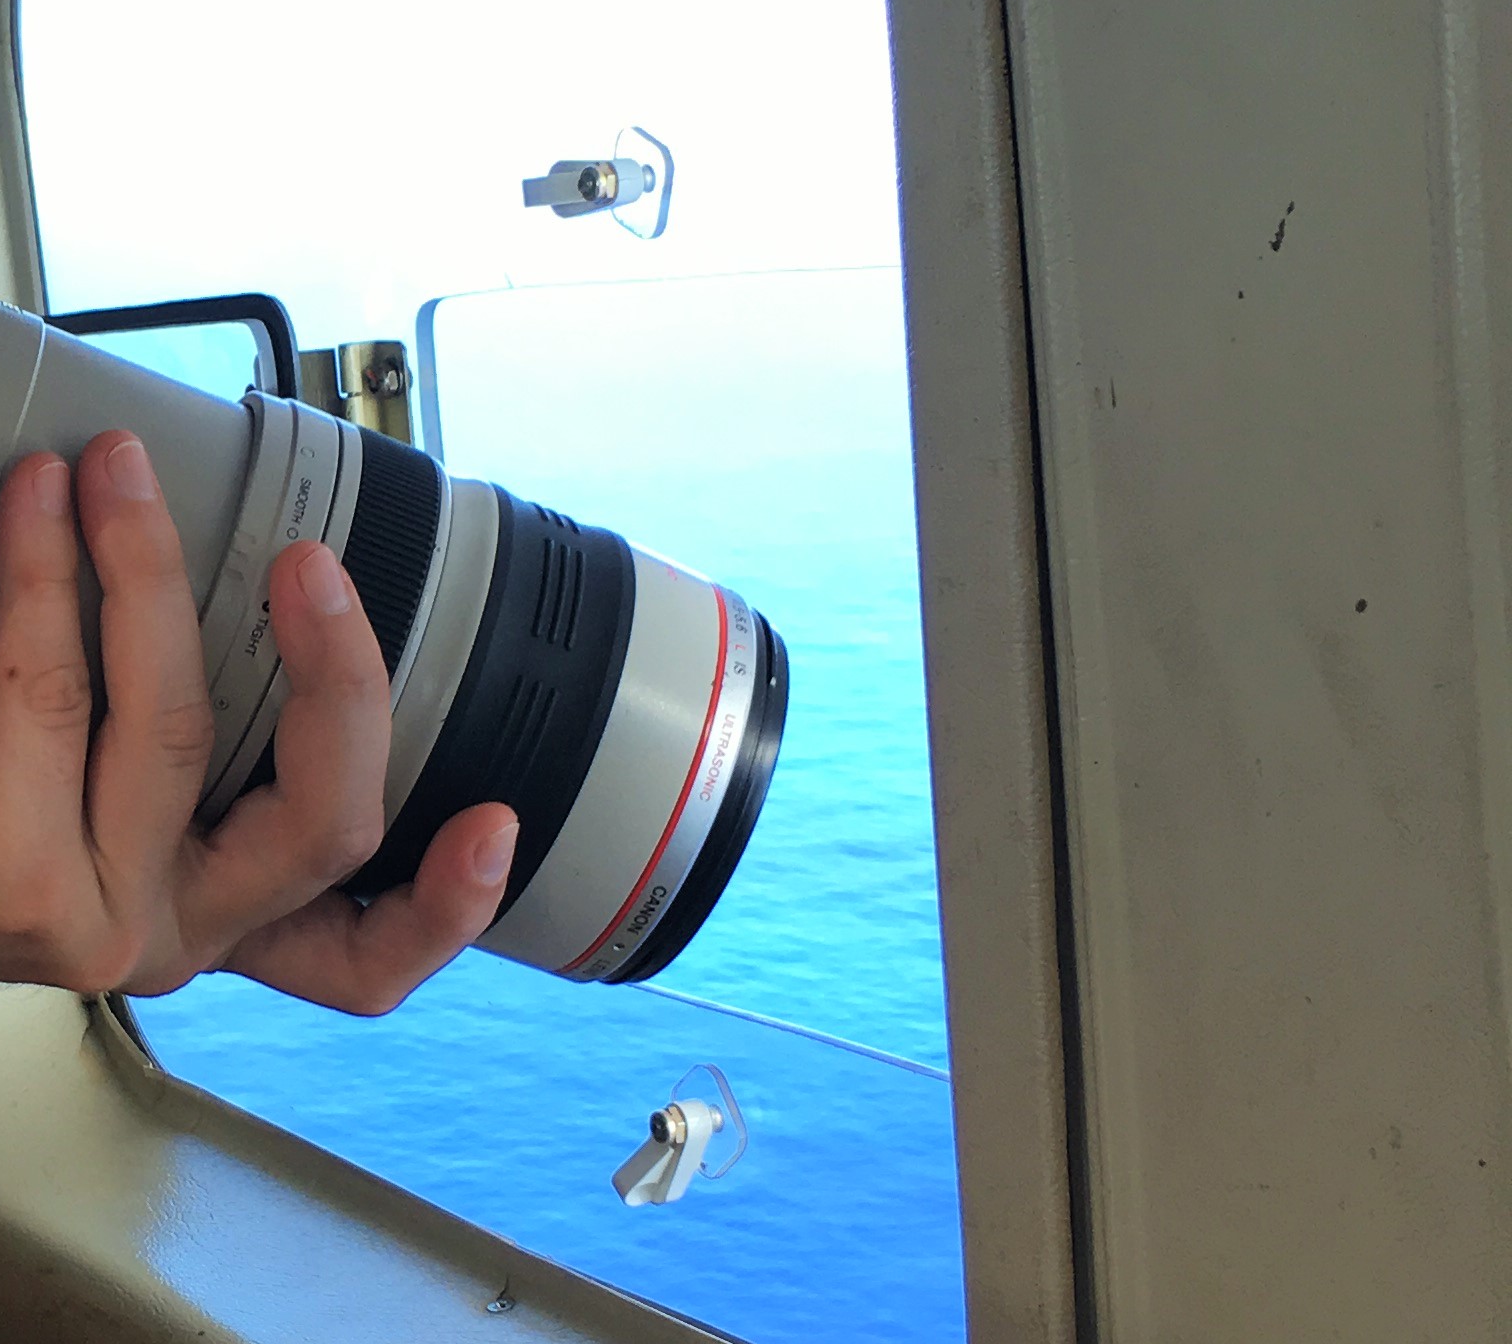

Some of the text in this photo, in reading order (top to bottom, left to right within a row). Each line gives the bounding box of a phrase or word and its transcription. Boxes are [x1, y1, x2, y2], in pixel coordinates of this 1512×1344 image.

[291, 477, 312, 525] SMOOTH
[245, 618, 269, 658] TIGHT
[699, 712, 736, 803] ULTRASONIC
[626, 885, 667, 936] CANON
